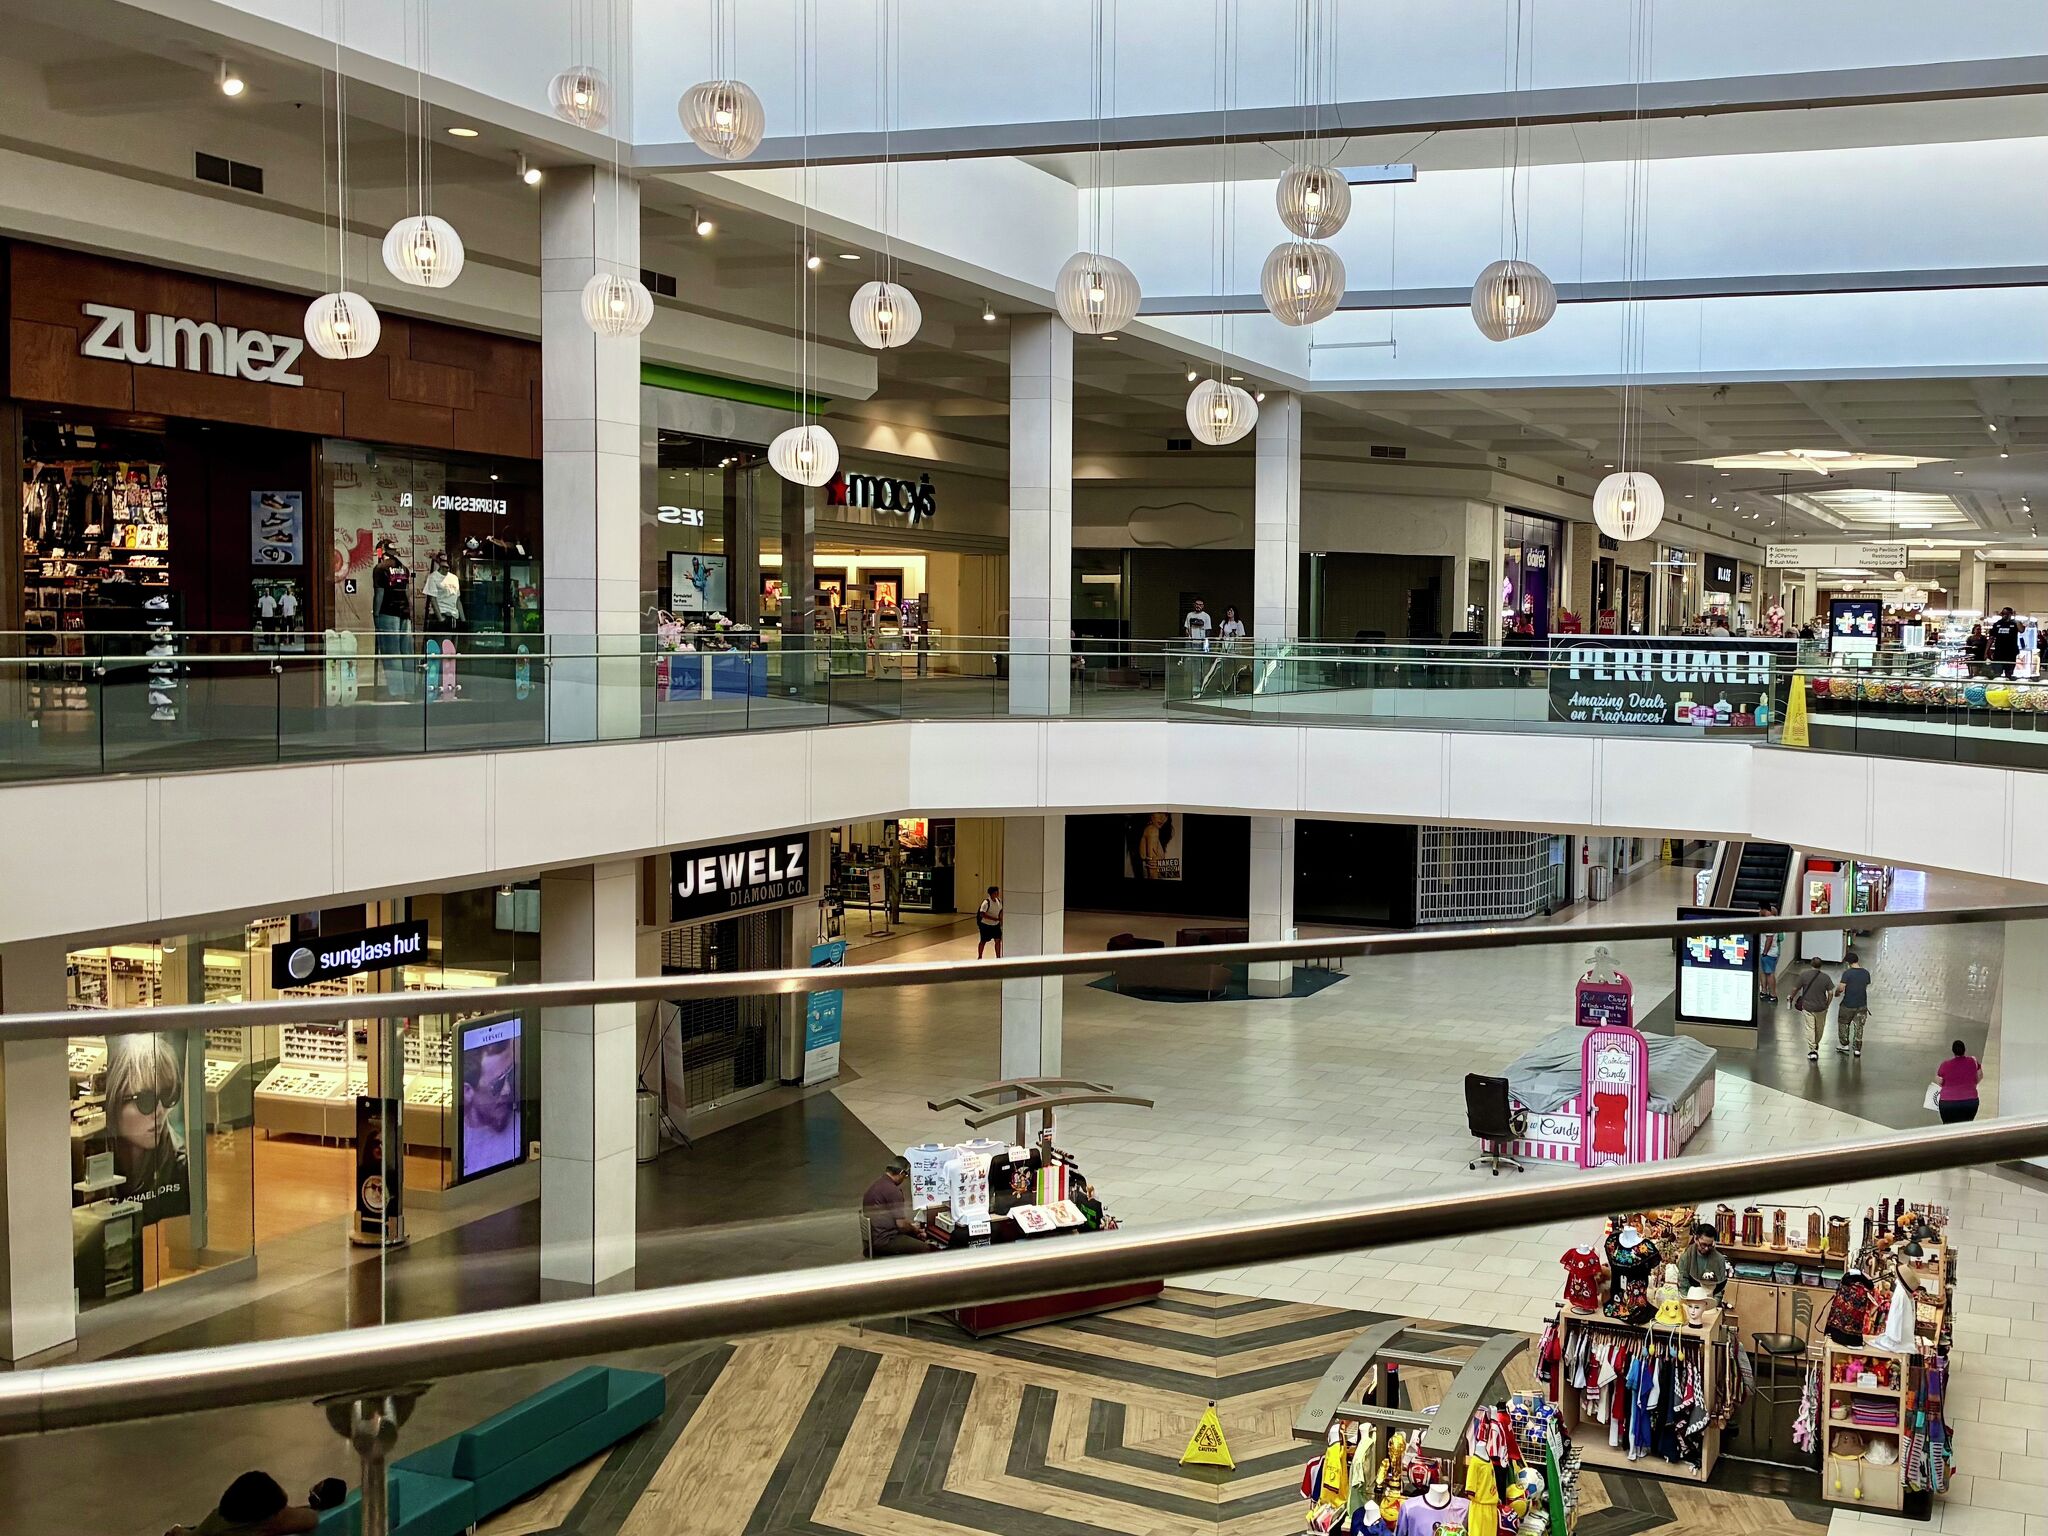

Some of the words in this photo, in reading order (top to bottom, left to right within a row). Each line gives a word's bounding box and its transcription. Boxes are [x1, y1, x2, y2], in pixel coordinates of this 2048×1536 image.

[1568, 691, 1624, 710] Amazing
[1629, 692, 1667, 708] Deals
[1570, 710, 1587, 721] on
[1592, 707, 1667, 723] Fragrances!
[678, 843, 804, 898] JEWELZ
[1157, 859, 1179, 867] NAKED
[730, 883, 784, 907] DIAMOND
[320, 940, 391, 969] sunglass
[394, 932, 421, 955] hut
[1598, 1066, 1626, 1081] Candy
[1540, 1117, 1580, 1141] Candy
